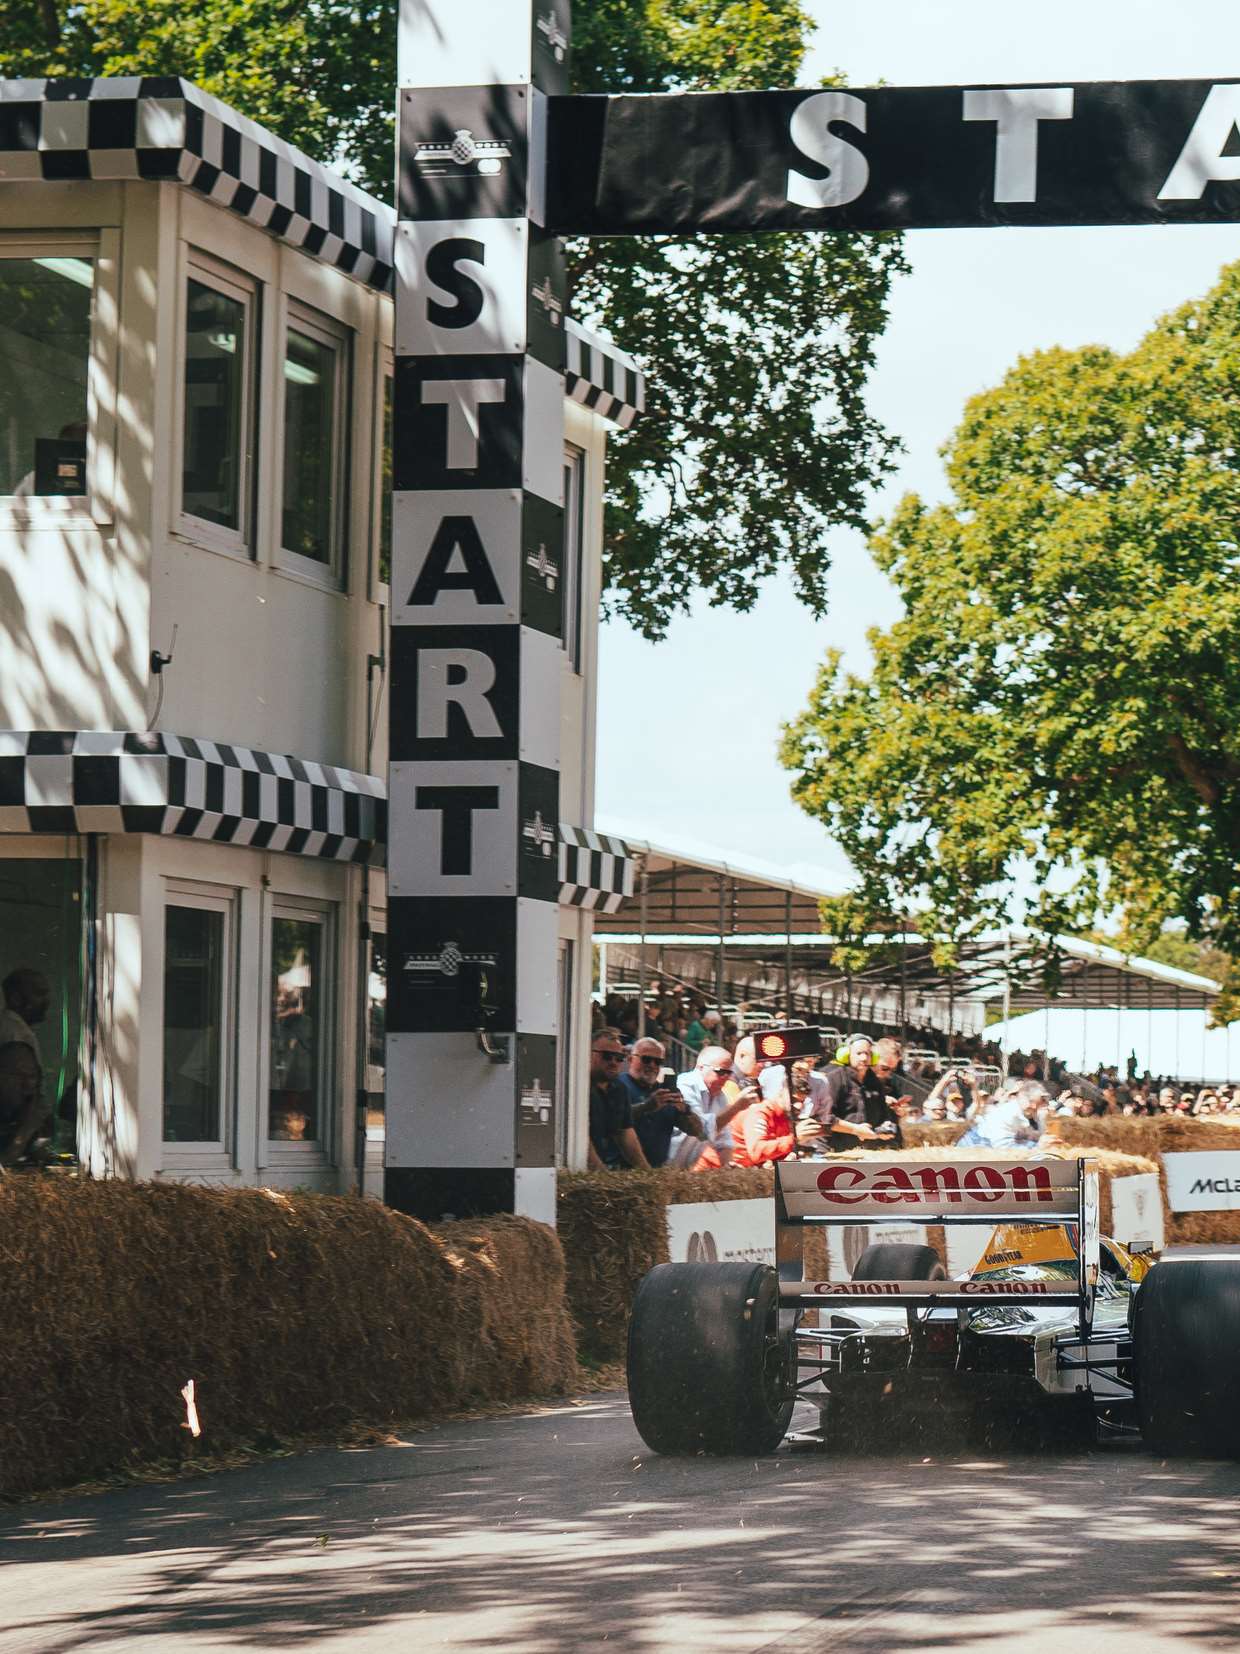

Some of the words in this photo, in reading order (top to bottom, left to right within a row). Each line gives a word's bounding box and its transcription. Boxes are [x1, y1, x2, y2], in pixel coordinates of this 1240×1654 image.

[406, 238, 505, 876] START
[817, 1166, 1054, 1205] Canon
[814, 1282, 900, 1295] Canon
[959, 1282, 1047, 1294] Canon
